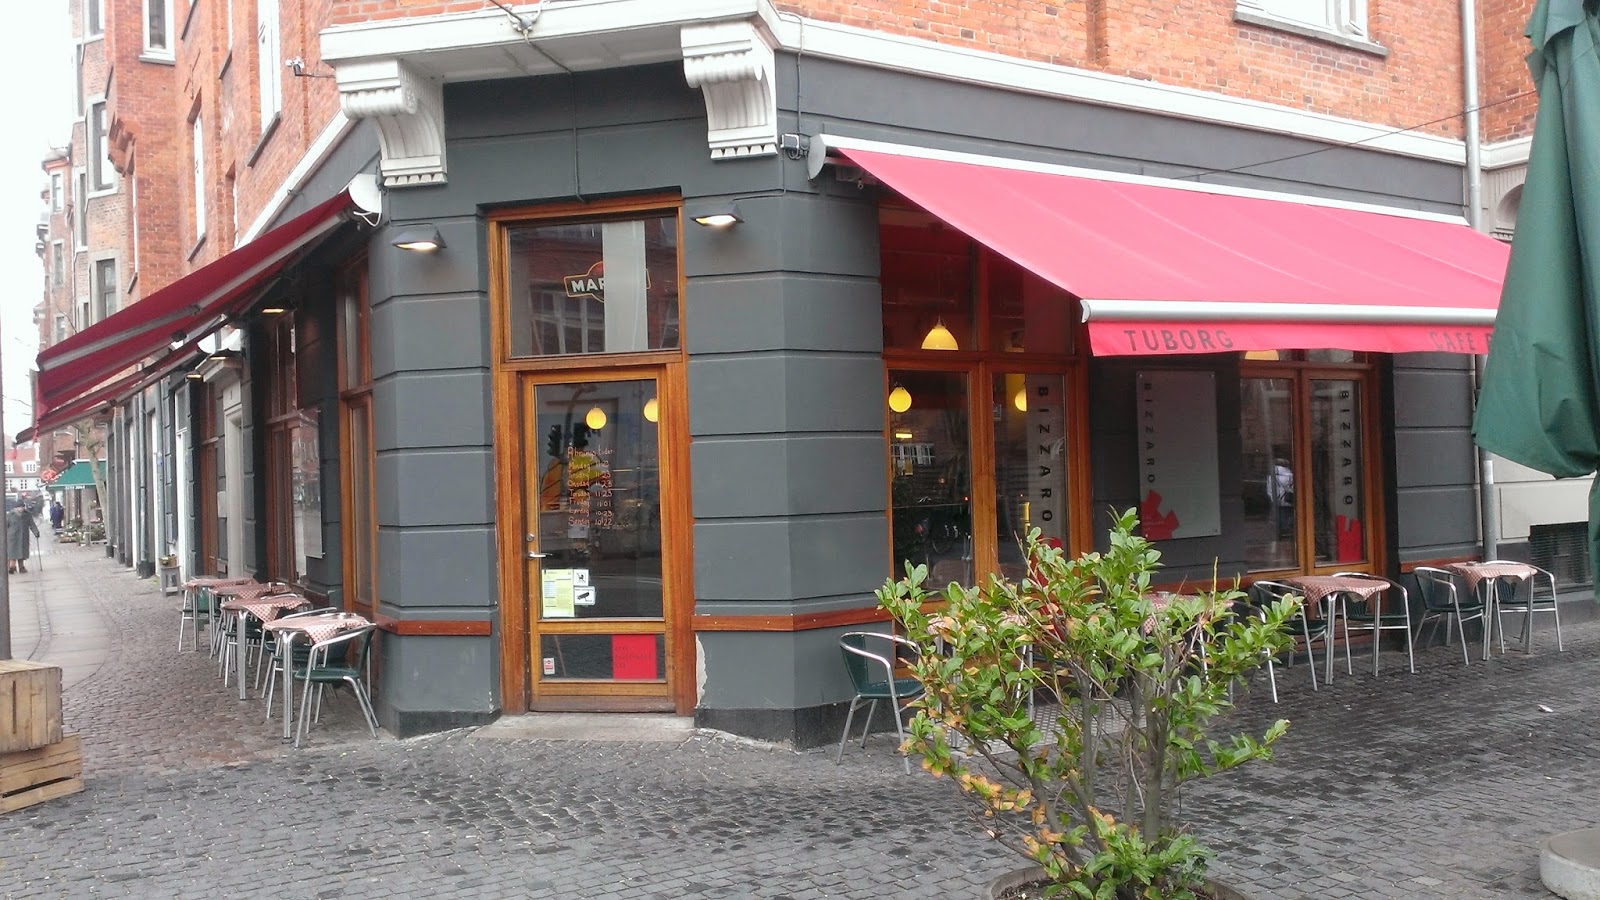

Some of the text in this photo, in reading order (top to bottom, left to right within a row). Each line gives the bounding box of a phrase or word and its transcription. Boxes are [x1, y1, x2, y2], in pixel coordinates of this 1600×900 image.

[1123, 329, 1234, 352] TUBORG
[1037, 386, 1053, 522] BIZZARO
[1143, 382, 1156, 484] BIZZARO
[1338, 390, 1354, 506] BIZZARO
